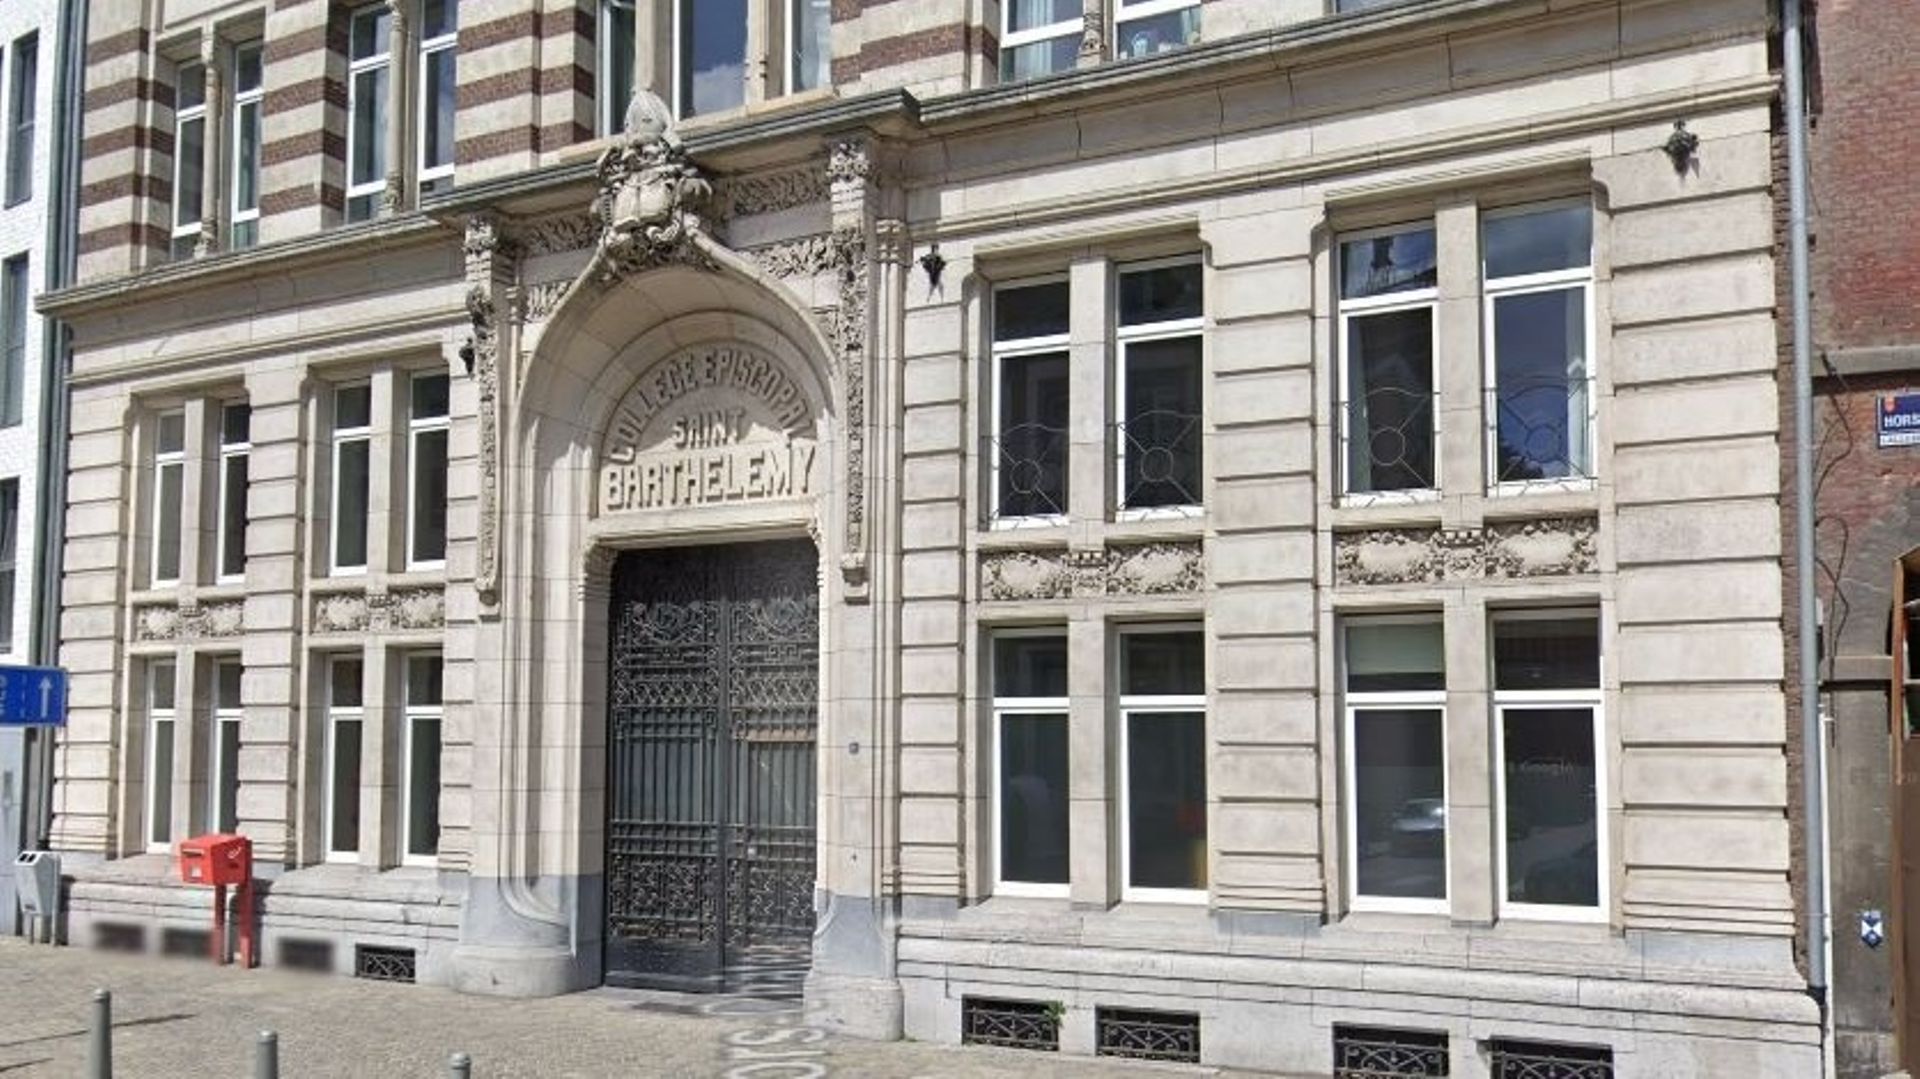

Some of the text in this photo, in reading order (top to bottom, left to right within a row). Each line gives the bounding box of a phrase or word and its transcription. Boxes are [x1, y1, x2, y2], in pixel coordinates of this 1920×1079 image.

[703, 348, 817, 441] EPISCOPAL
[673, 407, 747, 449] SAINT
[607, 446, 817, 510] BARTHELEMY
